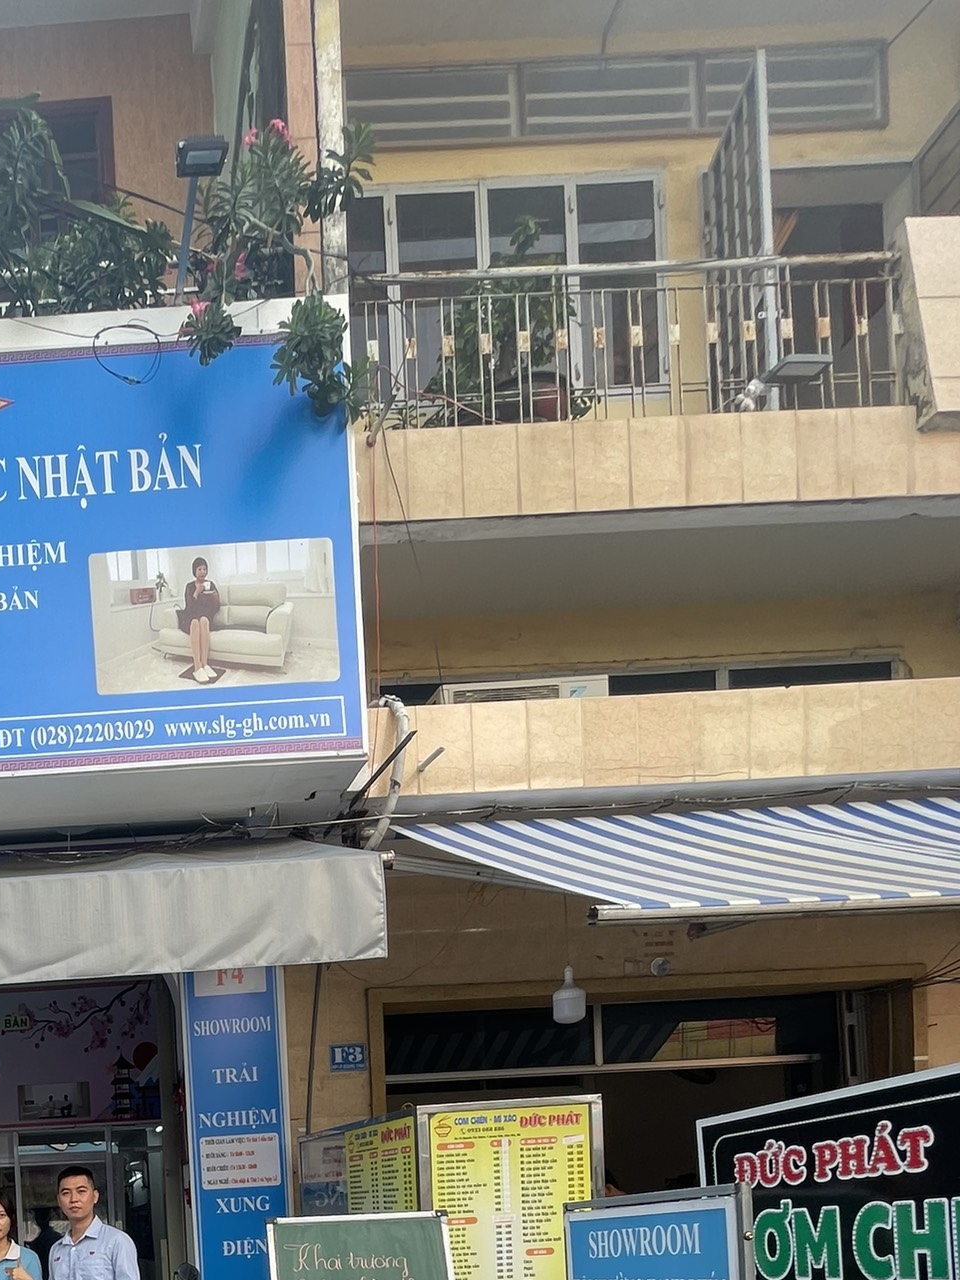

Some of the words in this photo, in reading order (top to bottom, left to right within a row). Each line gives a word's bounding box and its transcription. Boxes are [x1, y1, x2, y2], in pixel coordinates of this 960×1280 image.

[18, 445, 118, 509] NHẬT
[127, 432, 202, 492] BẢN
[30, 718, 154, 749] (028)22203029
[164, 712, 330, 740] www.slg-gh.com.vn
[216, 967, 244, 986] F4
[4, 1015, 28, 1028] BẢN
[193, 1016, 271, 1037] SHOWROOM
[334, 1046, 363, 1063] F3
[212, 1062, 258, 1084] TRẢI
[198, 1107, 277, 1129] NGHIỆM
[734, 1138, 806, 1188] ĐỨC
[812, 1120, 934, 1183] PHÁT
[216, 1195, 270, 1214] XUNG
[222, 1237, 268, 1258] ĐIỆN
[588, 1222, 701, 1260] SHOWROOM
[283, 1242, 343, 1272] Khai
